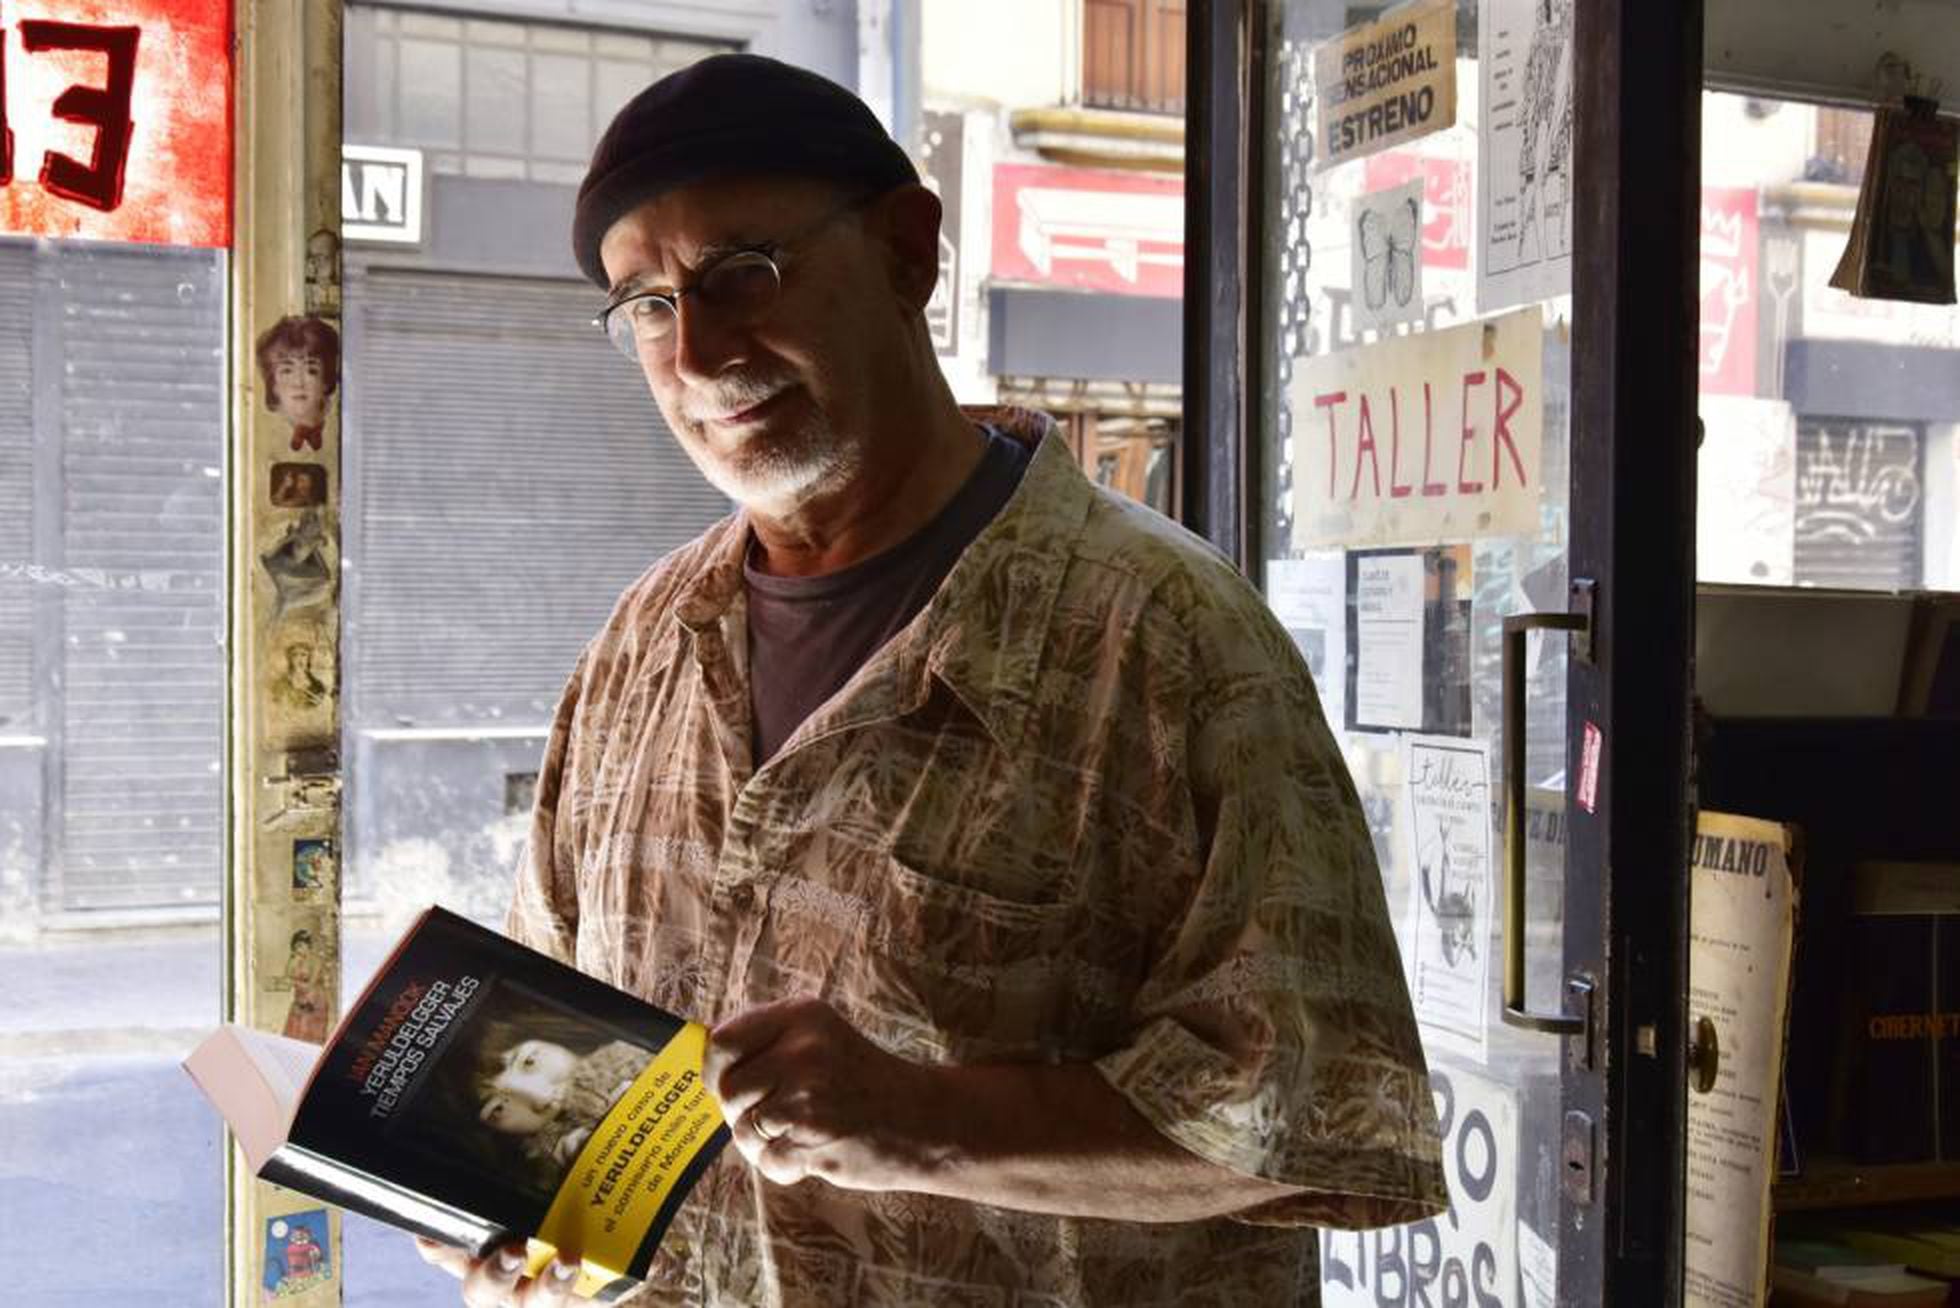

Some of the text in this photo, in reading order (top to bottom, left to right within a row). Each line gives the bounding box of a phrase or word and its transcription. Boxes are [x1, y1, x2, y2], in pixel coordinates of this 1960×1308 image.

[1328, 85, 1434, 155] ESTRENO
[1314, 367, 1527, 500] TALLER
[360, 980, 451, 1096] YERULDELGGER
[370, 976, 480, 1118] TIEMPOS SALVAJES
[627, 1091, 655, 1121] caso
[655, 1071, 671, 1088] de
[591, 1069, 699, 1206] YERULDELGGER
[647, 1173, 663, 1193] de
